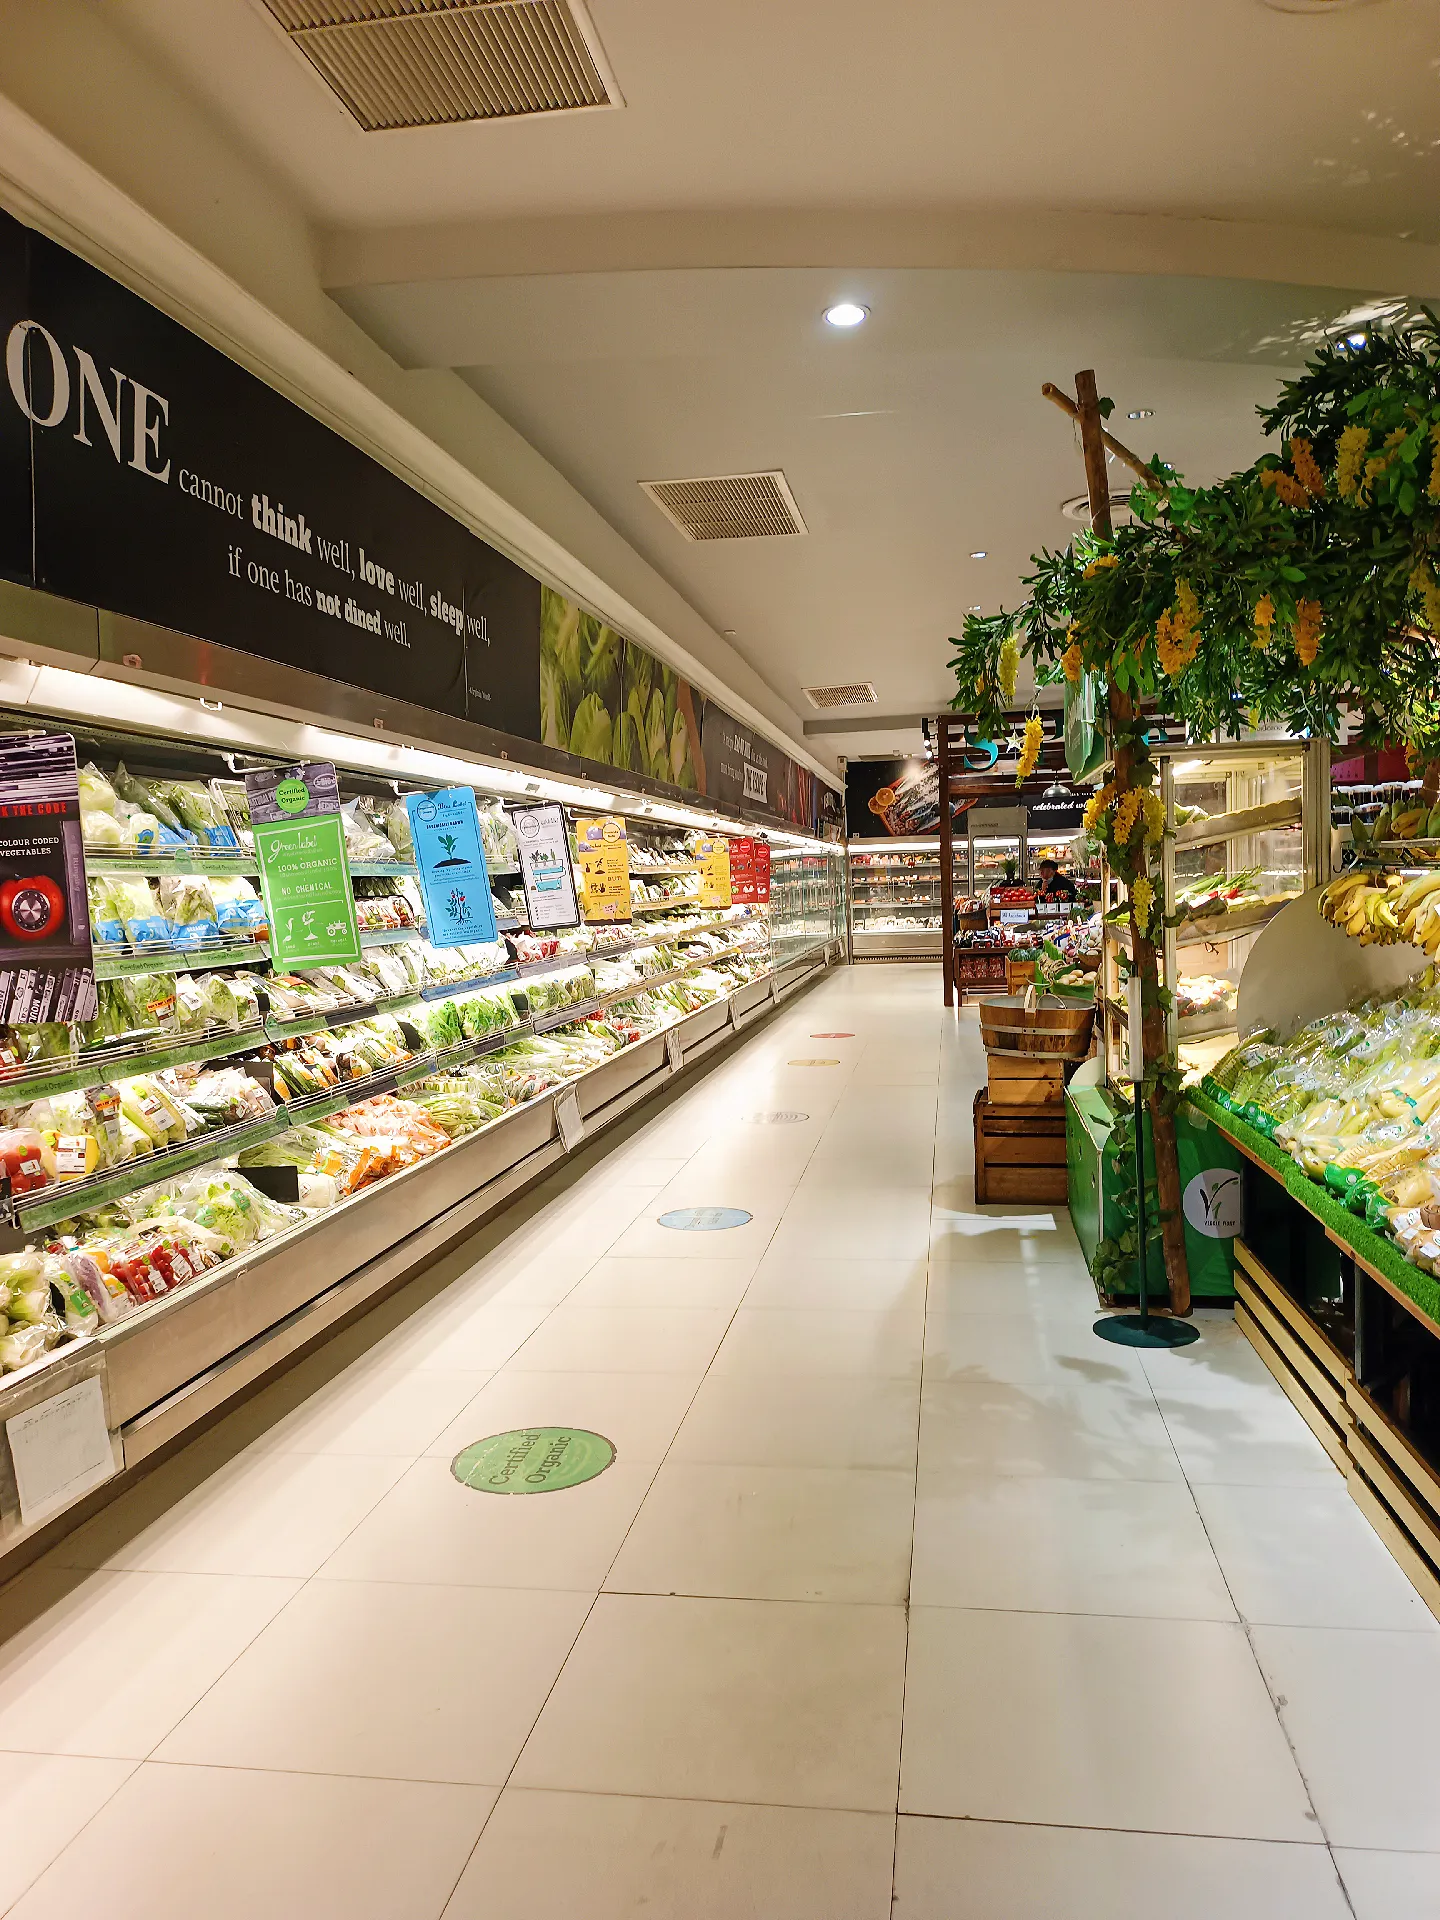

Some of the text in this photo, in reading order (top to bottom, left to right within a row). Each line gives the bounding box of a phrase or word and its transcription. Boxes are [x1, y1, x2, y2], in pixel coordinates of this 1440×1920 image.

[6, 319, 491, 647] ONE cannot think well, love well, sleep well,
[228, 544, 412, 649] if one has not dined well.
[278, 787, 306, 796] Certified
[281, 796, 306, 804] Organic
[1032, 800, 1075, 811] celebrated
[13, 803, 34, 817] THE
[37, 802, 67, 815] CODE
[32, 836, 60, 846] CODED
[0, 847, 52, 857] VEGETABLES
[277, 858, 338, 872] 100% ORGANIC
[281, 887, 292, 896] NO
[295, 881, 333, 894] CHEMICAL
[488, 1433, 572, 1485] Certified Organic
